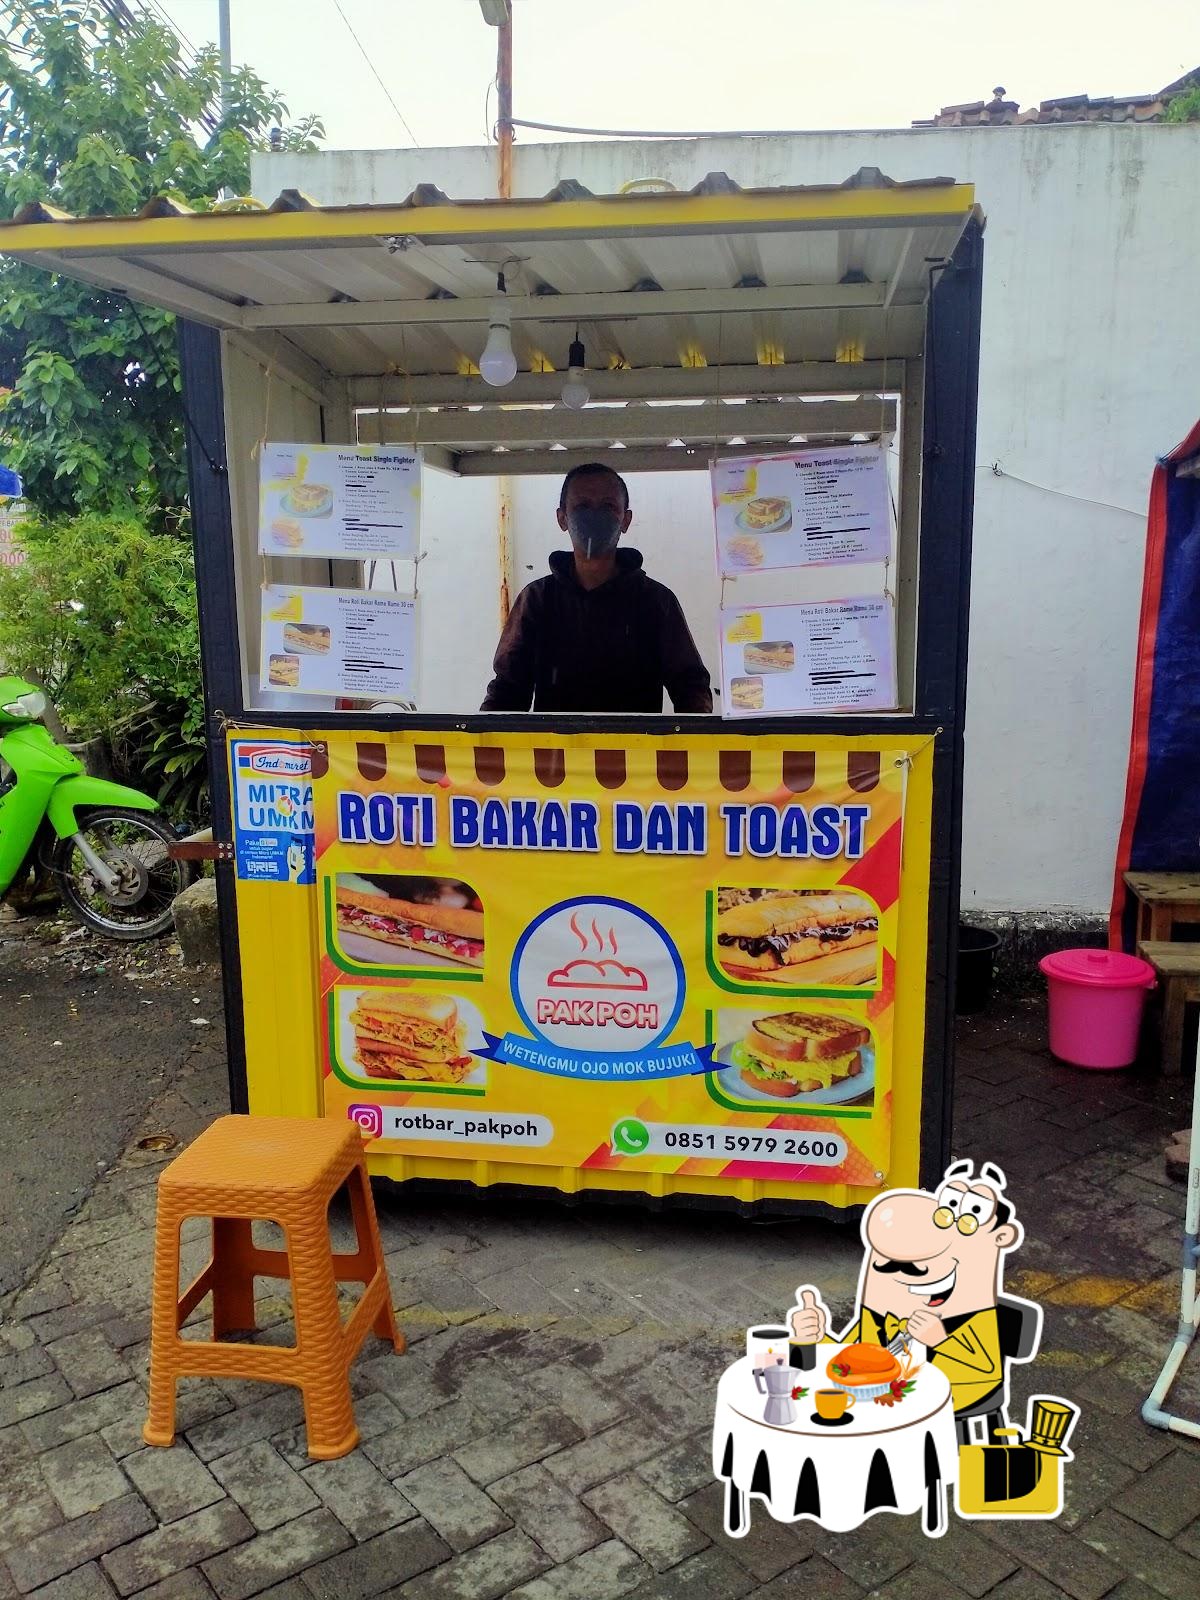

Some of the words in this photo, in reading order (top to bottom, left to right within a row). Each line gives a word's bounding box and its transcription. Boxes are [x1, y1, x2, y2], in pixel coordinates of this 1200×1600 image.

[373, 456, 392, 464] Single
[393, 457, 416, 465] Fighter
[814, 459, 833, 467] Toast
[833, 458, 854, 466] Single
[248, 784, 313, 806] MITRA
[337, 792, 436, 847] ROTI
[450, 796, 602, 853] BAKAR
[612, 801, 708, 856] DAN
[721, 802, 871, 860] TOAST
[537, 999, 594, 1026] PAK
[597, 1002, 658, 1029] POH
[503, 1040, 578, 1073] WETENGMU
[581, 1061, 609, 1075] OJO
[612, 1061, 646, 1075] MOK
[647, 1052, 697, 1072] BUJUKI
[395, 1113, 538, 1139] rotbar_pakpoh
[665, 1131, 716, 1150] 0851
[724, 1135, 777, 1152] 5979
[784, 1139, 839, 1158] 2600
